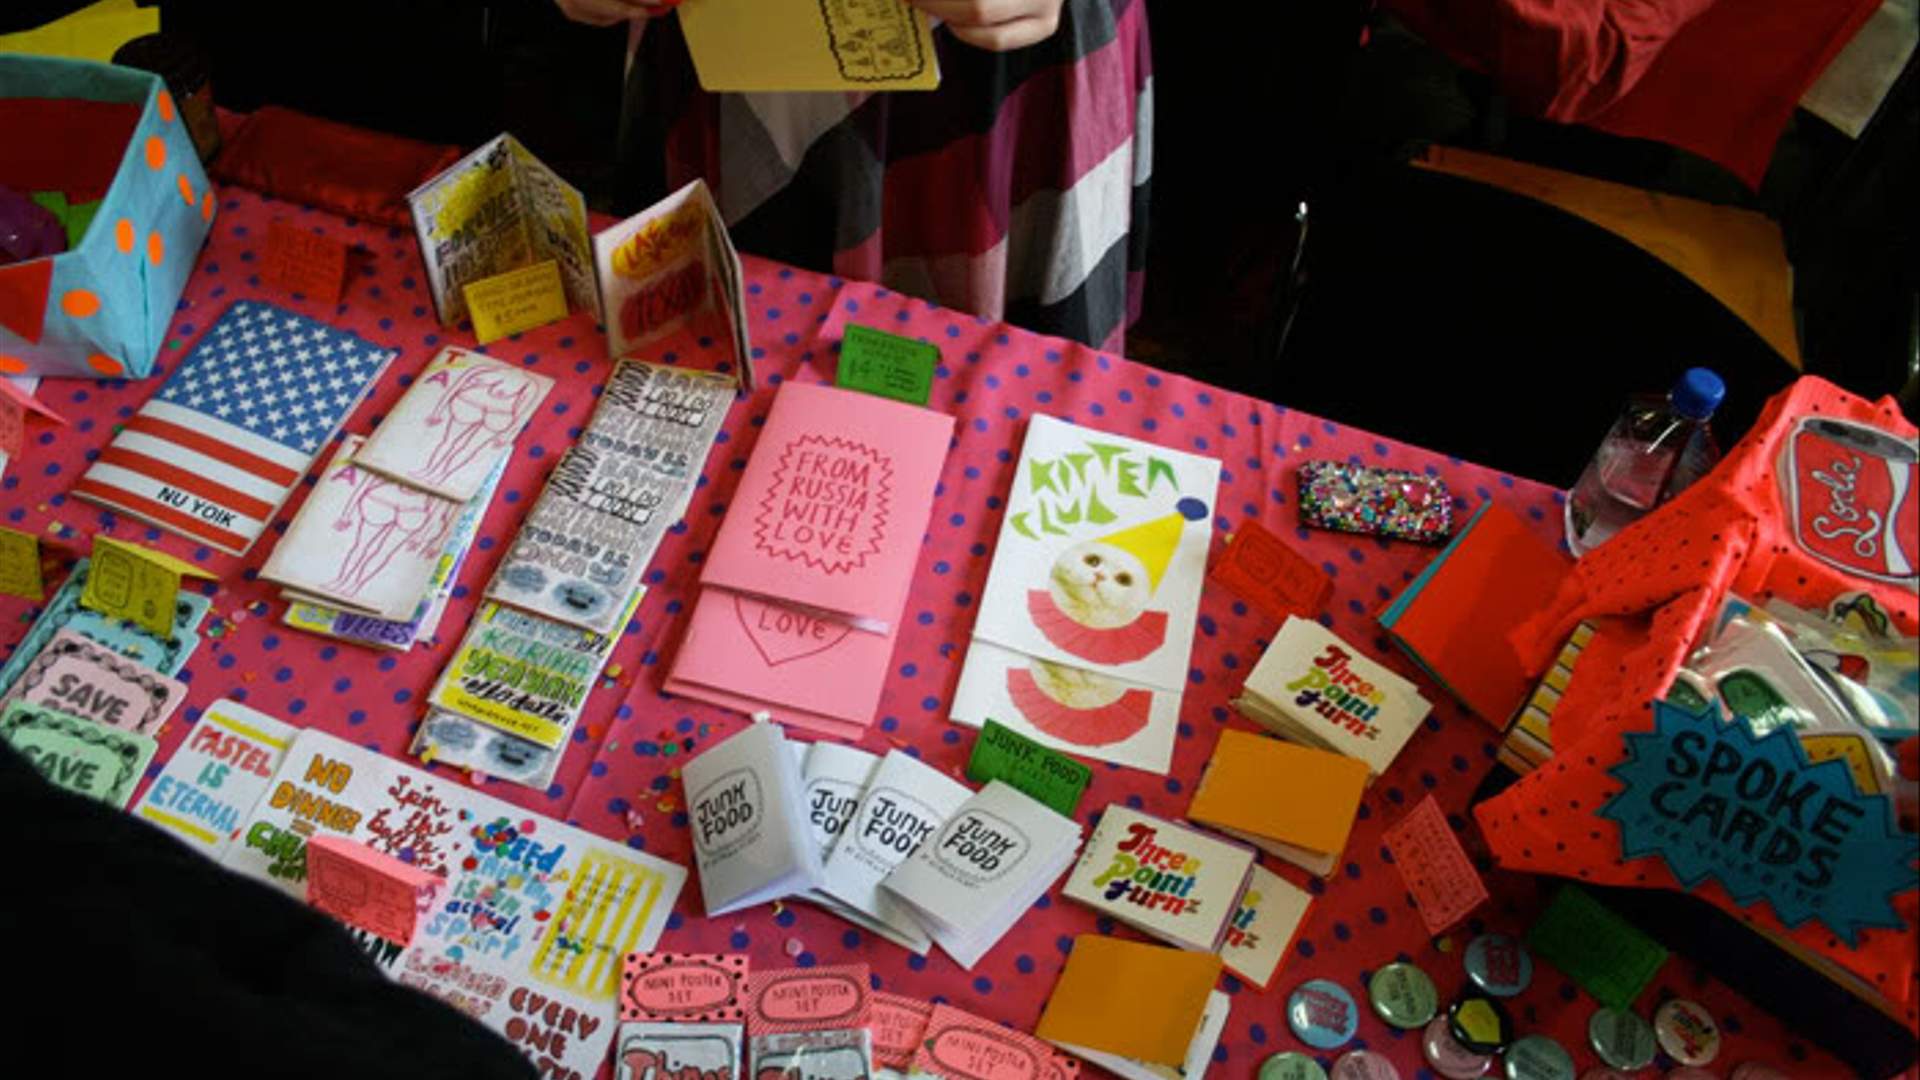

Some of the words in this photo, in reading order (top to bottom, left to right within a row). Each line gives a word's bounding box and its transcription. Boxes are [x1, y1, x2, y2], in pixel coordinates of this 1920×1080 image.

[797, 451, 870, 488] FROM
[1029, 441, 1180, 499] KITTEN
[158, 485, 189, 507] NU
[188, 493, 235, 528] YOIK
[782, 500, 860, 532] WITH
[789, 476, 869, 512] RUSSIA
[1812, 457, 1881, 558] Soda
[773, 522, 853, 555] LOVE
[759, 605, 829, 641] LOVE
[1285, 667, 1381, 723] Point
[1313, 644, 1386, 704] Three
[51, 674, 129, 725] SAVE
[189, 724, 273, 778] PASTEL
[304, 753, 353, 795] NO
[196, 761, 230, 788] IS
[1665, 731, 1865, 846] SPOKE
[152, 775, 241, 833] ETERNAL
[269, 780, 363, 834] DINNER
[702, 802, 753, 845] FOOD
[811, 788, 859, 818] JUN
[943, 832, 999, 872] FOOD
[1117, 822, 1201, 873] Three
[1651, 781, 1840, 889] CARDS
[1093, 854, 1198, 900] Point
